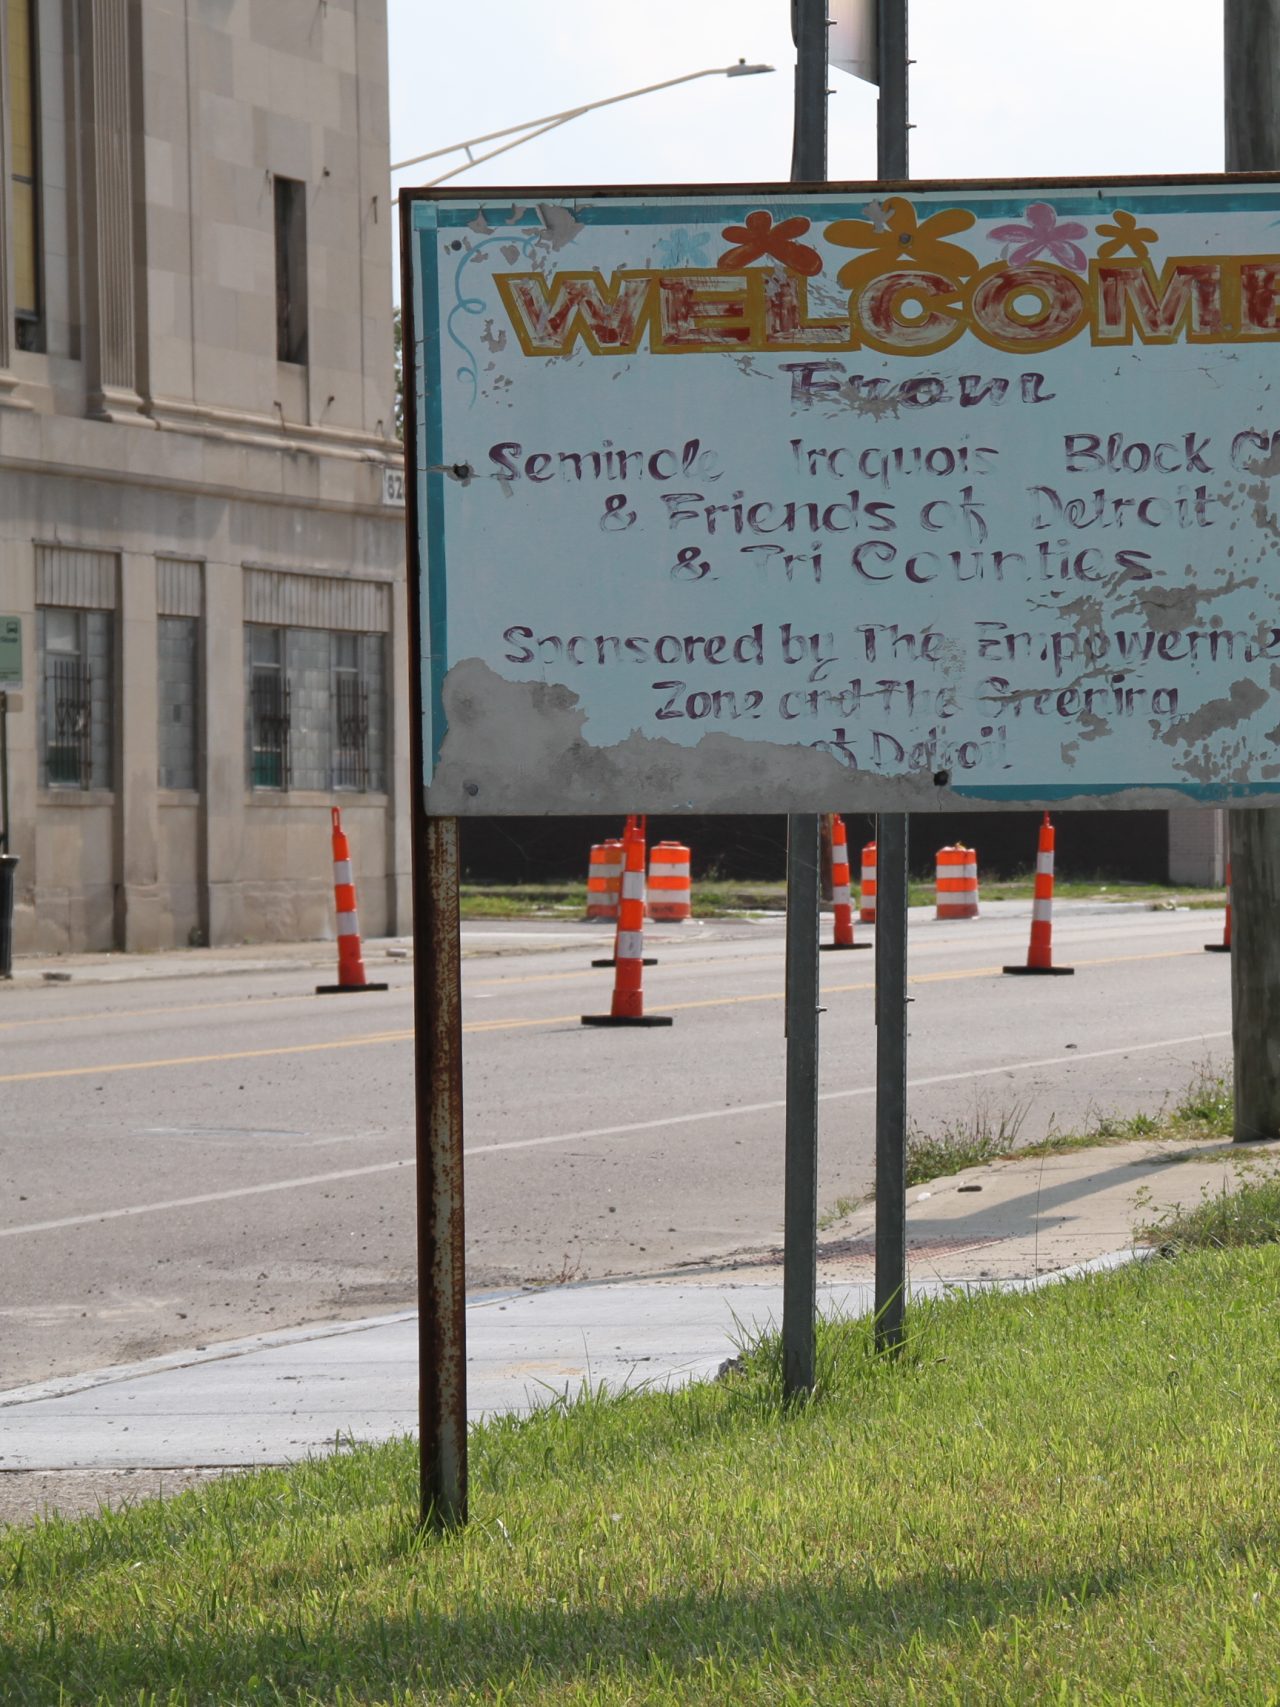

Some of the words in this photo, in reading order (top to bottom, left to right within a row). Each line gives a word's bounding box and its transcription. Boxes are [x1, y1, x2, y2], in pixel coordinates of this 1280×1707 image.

[489, 438, 725, 483] Seminole
[1064, 431, 1215, 474] Block
[600, 493, 638, 532] &
[660, 490, 897, 535] Friends
[920, 485, 988, 545] of
[1026, 485, 1216, 530] Detroit
[669, 546, 713, 583] &
[740, 541, 823, 584] Tri
[851, 538, 1153, 585] Counties
[779, 622, 839, 682] by
[855, 624, 944, 663] The
[652, 680, 764, 720] Zone
[779, 678, 862, 720] and
[876, 679, 956, 719] The
[809, 727, 858, 770] f
